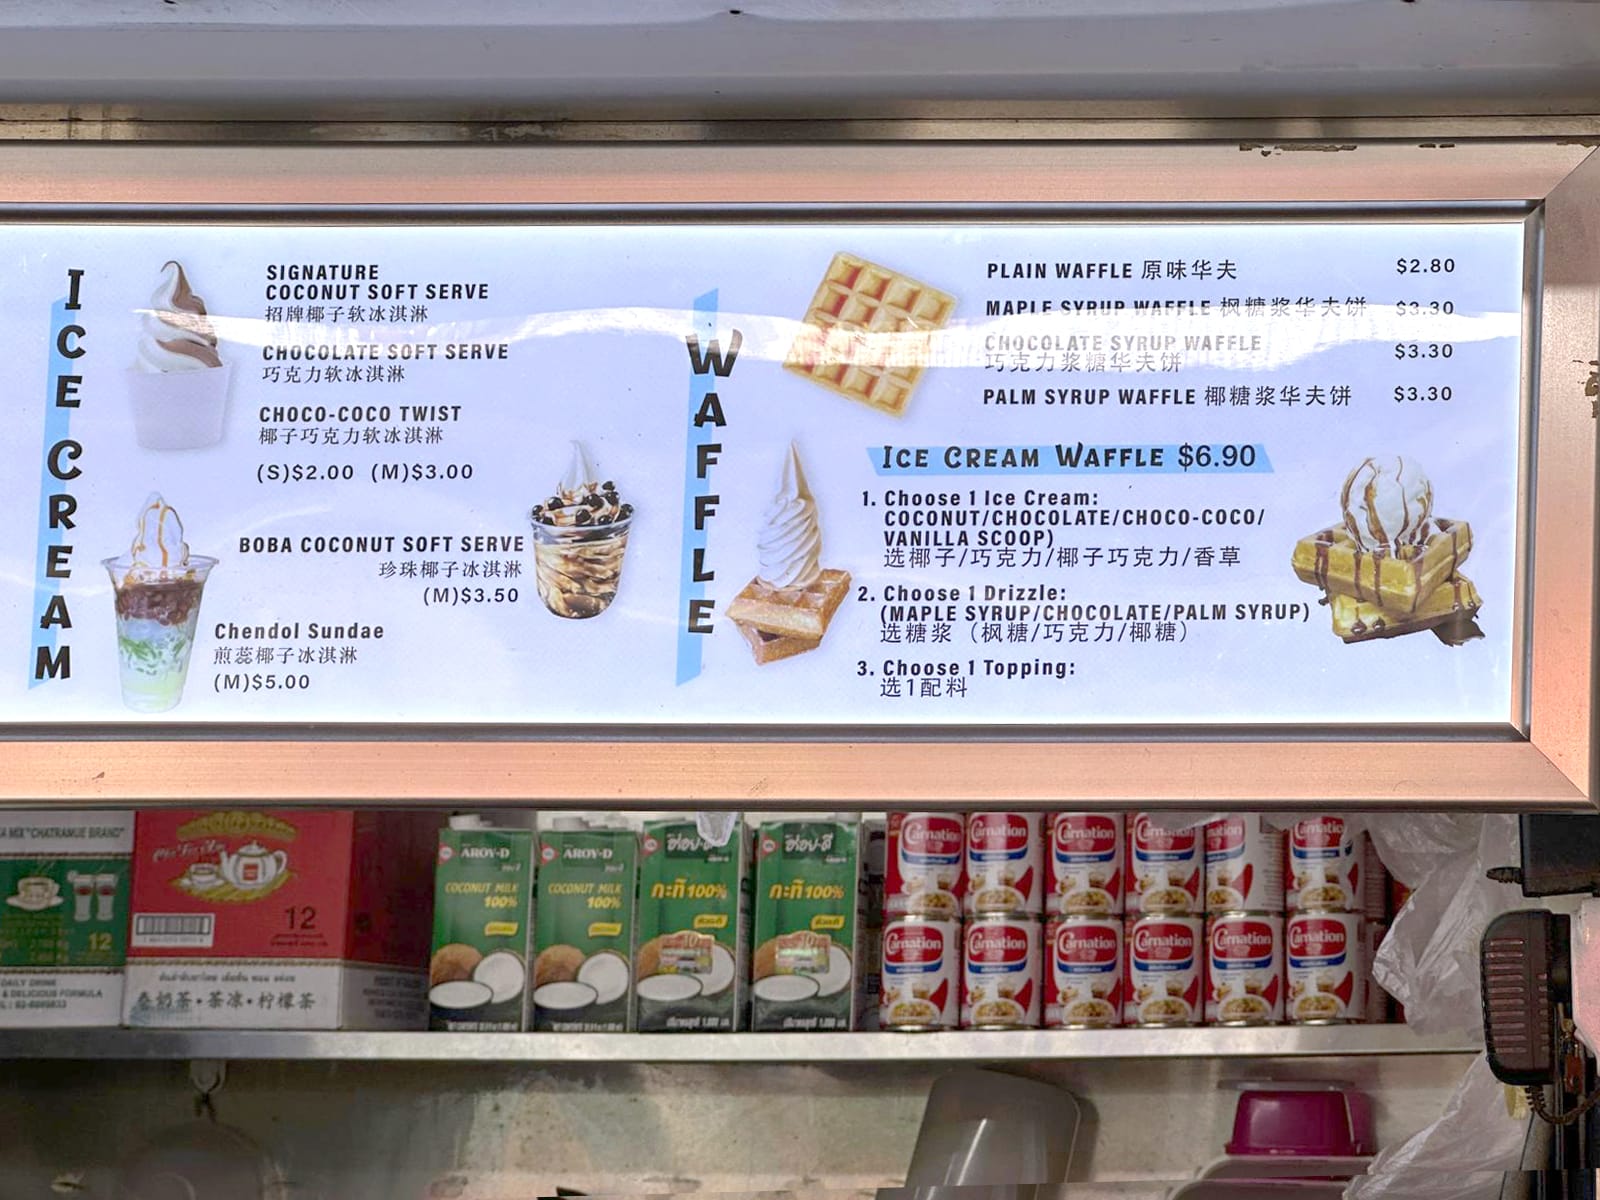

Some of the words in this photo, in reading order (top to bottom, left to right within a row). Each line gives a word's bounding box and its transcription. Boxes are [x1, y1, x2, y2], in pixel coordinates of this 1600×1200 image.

[266, 264, 379, 280] SIGNATURE
[987, 263, 1047, 279] PLAIN
[1055, 263, 1133, 279] WAFFLE
[1141, 259, 1237, 280] 原味华夫
[1396, 256, 1456, 276] $2.80
[265, 284, 360, 300] COCONUT
[367, 284, 418, 300] SOFT
[425, 283, 489, 299] SERVE
[264, 305, 429, 323] 招牌椰子软冰淇淋
[986, 300, 1052, 316] MAPLE
[1060, 300, 1126, 316] SYRUP
[1134, 300, 1211, 316] WAFFLE
[1220, 296, 1368, 317] 枫糖浆华夫饼
[1395, 300, 1454, 316] $3.30
[56, 269, 86, 408] ICE
[985, 335, 1102, 351] CHOCOLATE
[1110, 335, 1177, 351] SYRUP
[1184, 335, 1261, 351] WAFFLE
[262, 344, 379, 361] CHOCOLATE
[387, 344, 438, 360] SOFT
[445, 343, 509, 360] SERVE
[1394, 343, 1454, 360] $3.30
[984, 351, 1183, 373] 巧克力浆糖华夫饼
[262, 366, 406, 384] 巧克力软冰淇淋
[983, 389, 1036, 405] PALM
[1044, 389, 1110, 405] SYRUP
[1118, 389, 1196, 405] WAFFLE
[1204, 385, 1352, 407] 椰糖浆华夫饼
[1393, 385, 1453, 402] $3.30
[259, 406, 391, 423] CHOCO-COCO
[399, 405, 462, 421] TWIST
[258, 427, 444, 445] 椰子巧克力软冰淇淋
[1178, 442, 1256, 472] $6.90
[257, 463, 354, 484] (S)$2.00
[371, 463, 474, 483] (M)$3.00
[686, 329, 743, 634] WAFFLE
[862, 491, 876, 506] 1.
[885, 490, 961, 506] Choose
[969, 491, 976, 506] 1
[984, 490, 1015, 506] Ice
[1024, 490, 1098, 506] Cream:
[884, 508, 1265, 527] COCONUT/CHOCOLATE/CHOCO-COCO/
[239, 537, 292, 553] BOBA
[301, 536, 396, 553] COCONUT
[402, 536, 453, 552] SOFT
[461, 536, 524, 552] SERVE
[884, 530, 969, 547] VANILLA
[977, 529, 1054, 548] SCOOP)
[35, 439, 83, 680] CREAM
[883, 546, 1241, 568] 选椰子/巧克力/椰子巧克力/香草
[378, 560, 523, 579] 珍珠椰子冰淇淋
[423, 587, 519, 606] (M)$3.50
[857, 586, 875, 602] 2.
[884, 585, 960, 602] Choose
[968, 585, 975, 601] 1
[984, 584, 1066, 601] Drizzle:
[880, 604, 957, 625] (MAPLE
[965, 604, 1227, 622] SYRUP/CHOCOLATE/PALM
[1235, 603, 1310, 622] SYRUP)
[215, 622, 299, 639] Chendol
[308, 622, 384, 639] Sundae
[857, 660, 875, 676] 3.
[883, 659, 960, 676] Choose
[968, 660, 975, 676] 1
[983, 658, 1076, 680] Topping:
[213, 673, 310, 693] (M)$5.00
[880, 676, 968, 698] 选1配料
[904, 821, 961, 845] Carnation
[970, 821, 1027, 843] Carnation
[1056, 822, 1114, 844] Carnation
[461, 846, 510, 859] AROY-D
[563, 847, 613, 860] AROY-D
[445, 882, 491, 894] COCONUT
[495, 882, 520, 894] MILK
[548, 883, 594, 895] COCONUT
[598, 883, 623, 895] MILK
[485, 896, 518, 909] 100%
[587, 896, 622, 909] 100%
[285, 906, 317, 930] 12
[89, 932, 113, 951] 12
[886, 933, 942, 955] Carnation
[970, 933, 1026, 955] Carnation
[1059, 933, 1117, 954] Carnation
[1135, 929, 1192, 951] Carnation
[1214, 928, 1272, 950] Carnation
[1289, 927, 1345, 949] Carnation
